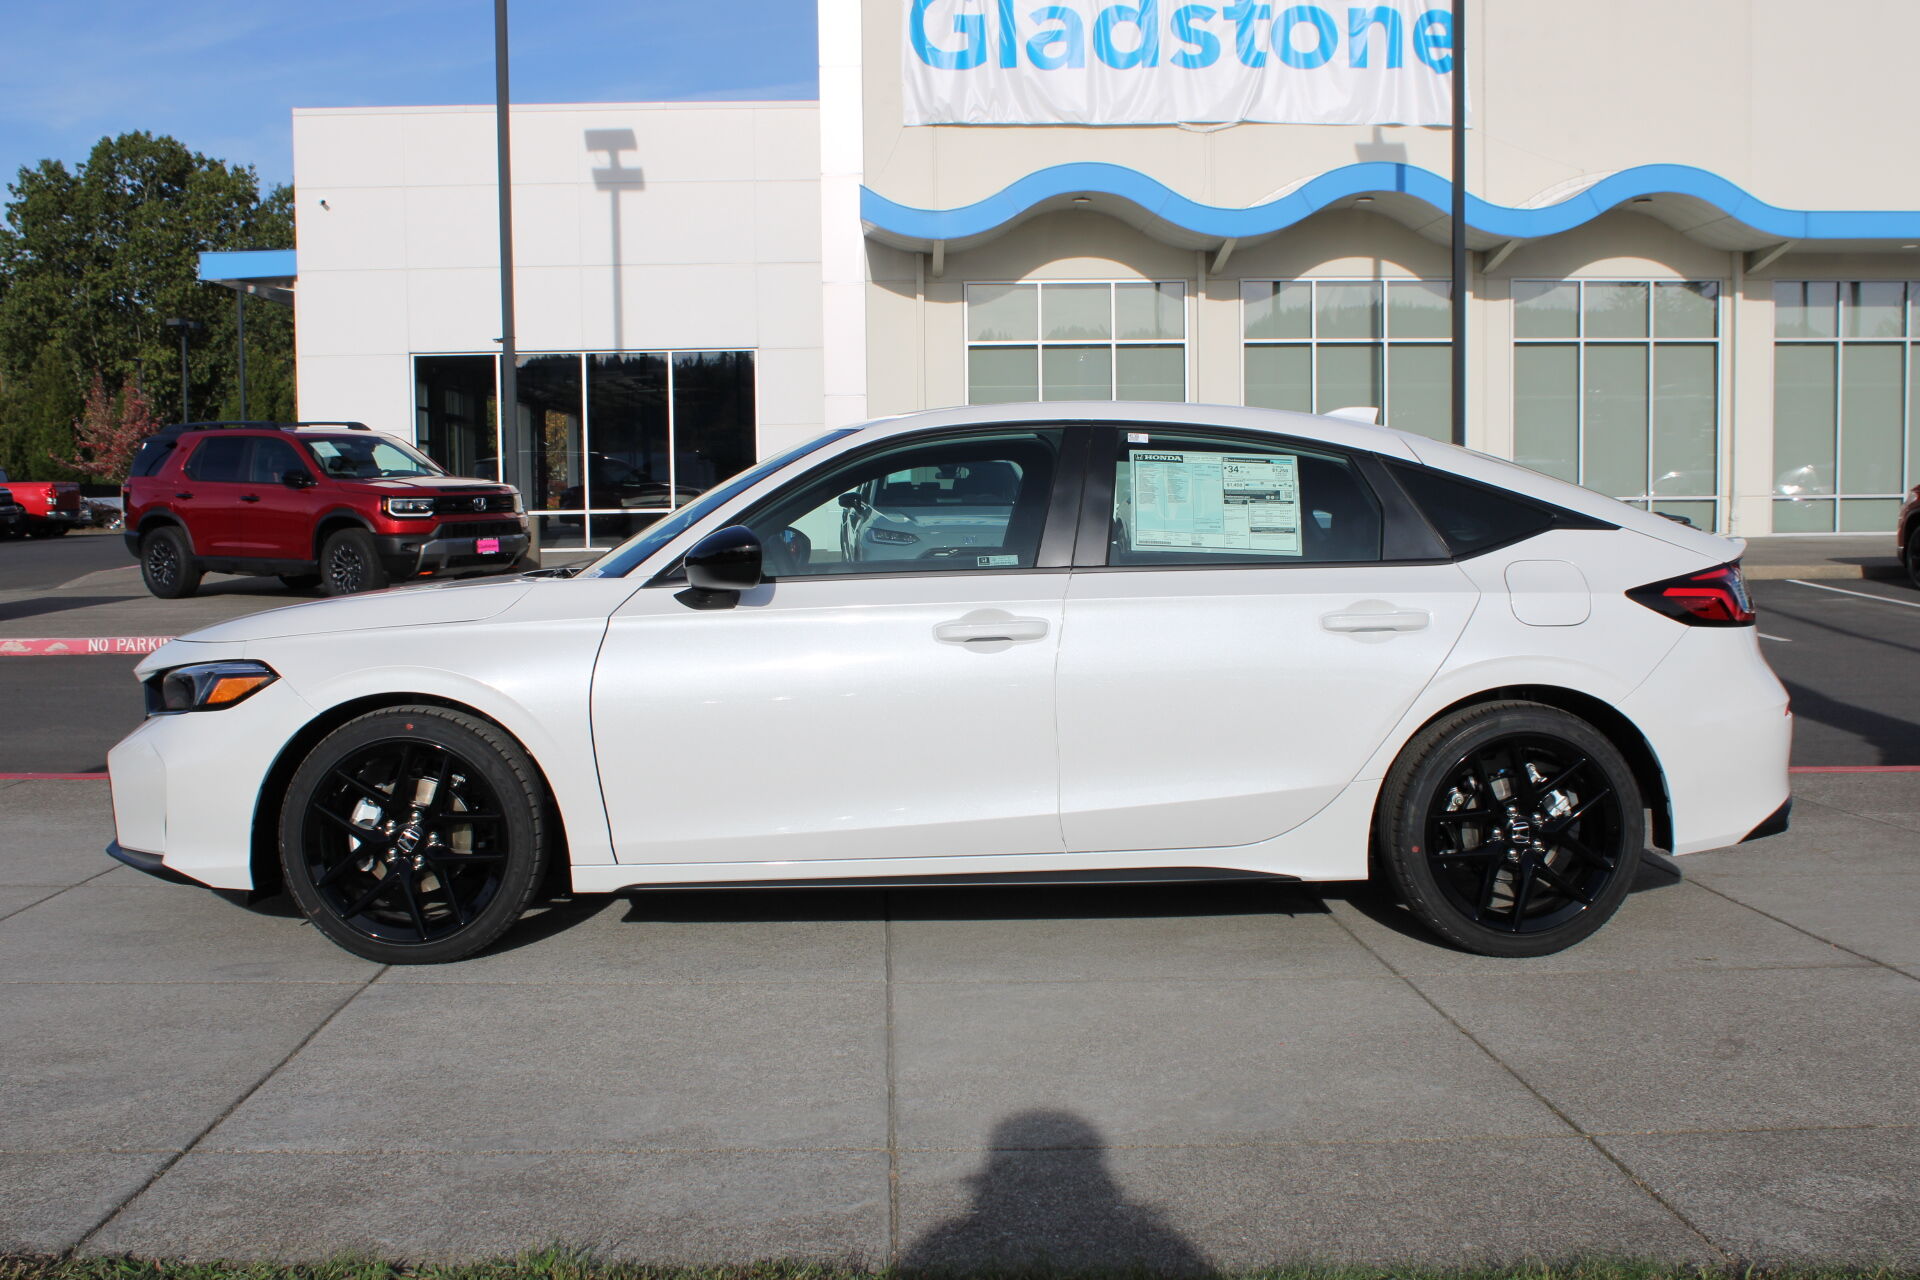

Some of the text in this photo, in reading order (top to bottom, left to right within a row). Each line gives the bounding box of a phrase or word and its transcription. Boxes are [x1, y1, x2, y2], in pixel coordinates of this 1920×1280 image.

[909, 0, 1453, 74] Gladstone
[1144, 454, 1182, 462] HONDA
[1227, 465, 1240, 473] 34
[88, 638, 109, 652] NO
